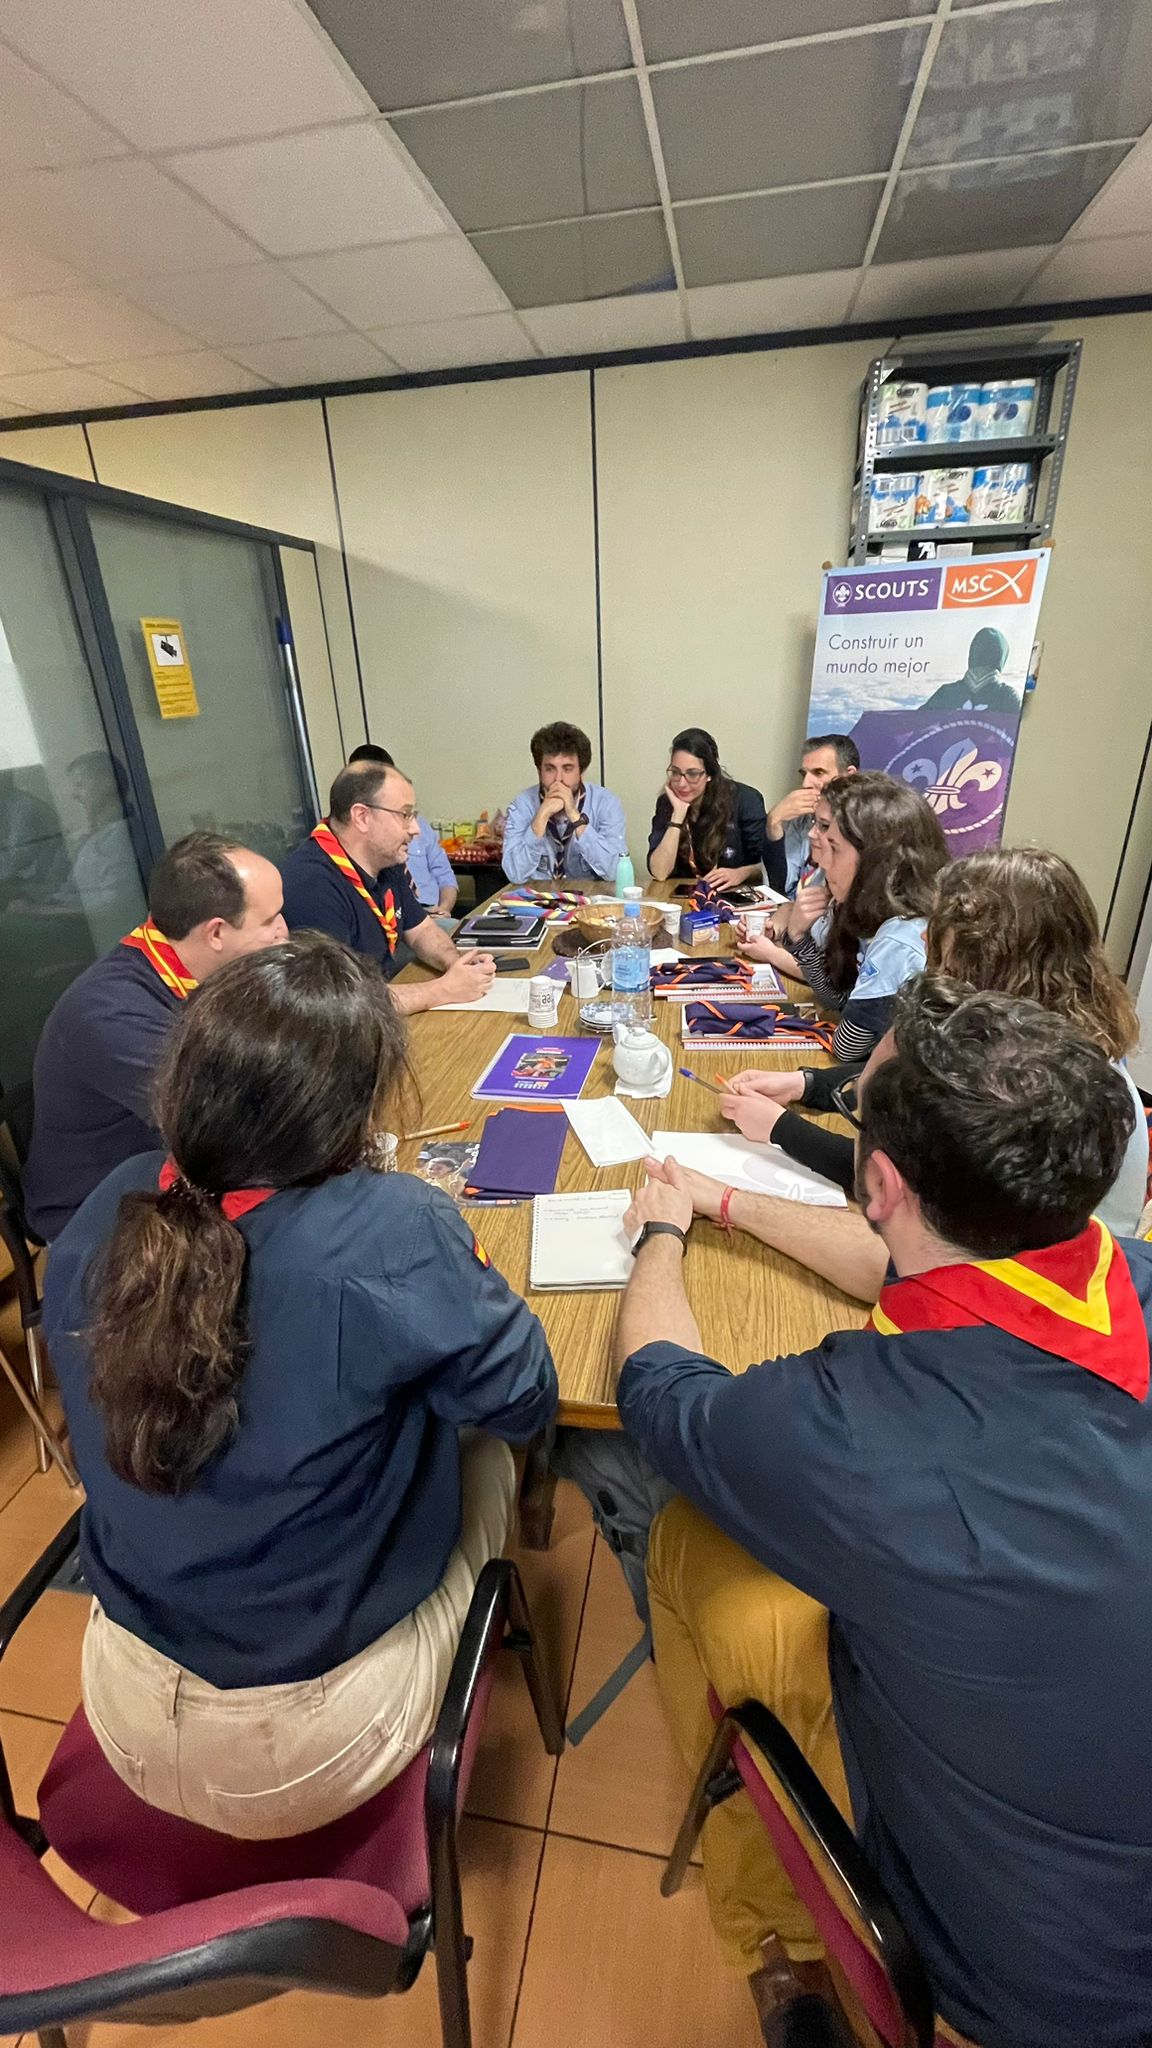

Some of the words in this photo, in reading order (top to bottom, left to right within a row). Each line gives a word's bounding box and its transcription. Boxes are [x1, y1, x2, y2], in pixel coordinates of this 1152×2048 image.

[854, 579, 929, 600] SCOUTS
[951, 574, 994, 594] MSC
[828, 633, 899, 650] Construir
[905, 636, 924, 648] un
[826, 656, 878, 674] mundo
[884, 657, 930, 678] mejor
